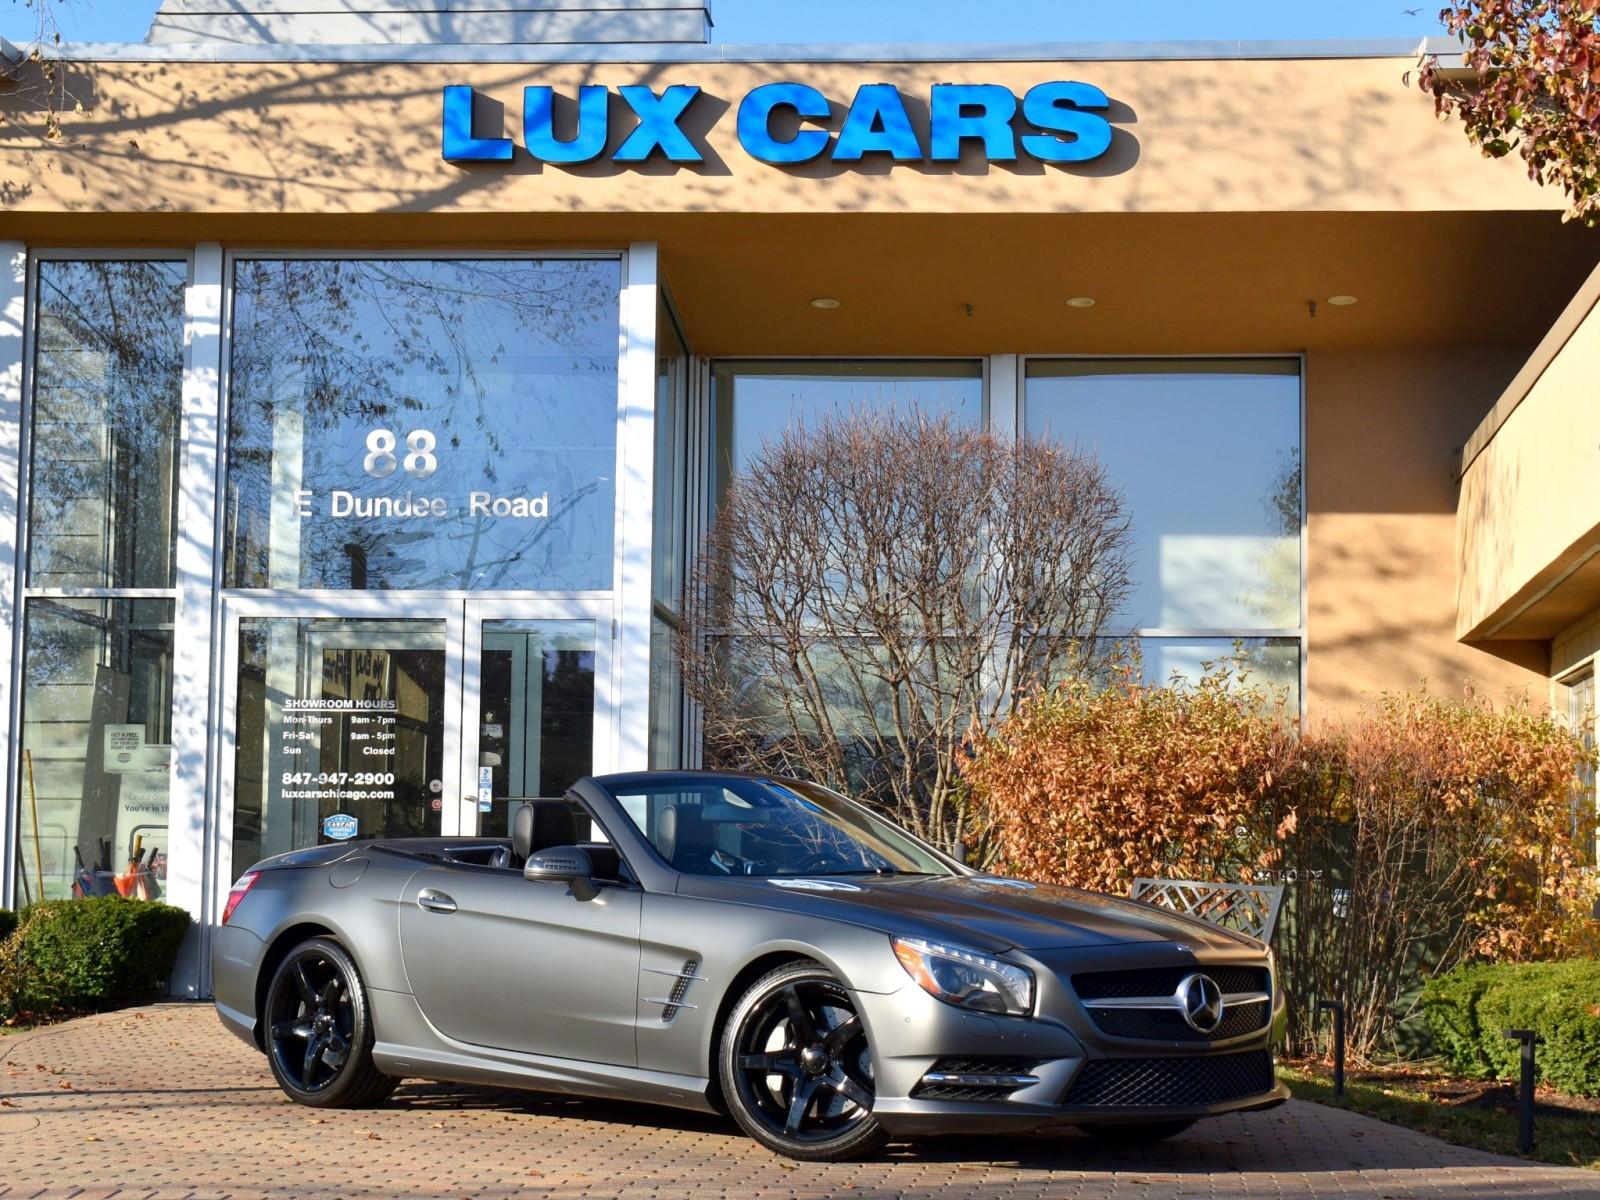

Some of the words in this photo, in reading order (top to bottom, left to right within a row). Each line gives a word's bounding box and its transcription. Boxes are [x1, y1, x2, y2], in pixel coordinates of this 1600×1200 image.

[442, 84, 704, 165] LUX
[737, 80, 1113, 165] CARS
[363, 428, 438, 479] 88
[293, 490, 313, 517] E
[331, 490, 449, 517] Dundee
[469, 491, 549, 517] Road
[284, 699, 353, 709] SHOWROOM
[355, 699, 396, 709] HOURS
[282, 715, 333, 724] Mon-Thurs
[351, 715, 370, 724] 9am
[377, 716, 396, 725] 7pm
[282, 731, 315, 740] Fri-Sat
[350, 732, 370, 740] 9am
[376, 732, 396, 741] 5pm
[282, 746, 302, 754] Sun
[362, 746, 395, 755] Closed
[281, 772, 395, 785] 847-947-2900
[281, 788, 395, 800] luxcarschicago.com
[124, 804, 151, 812] You're
